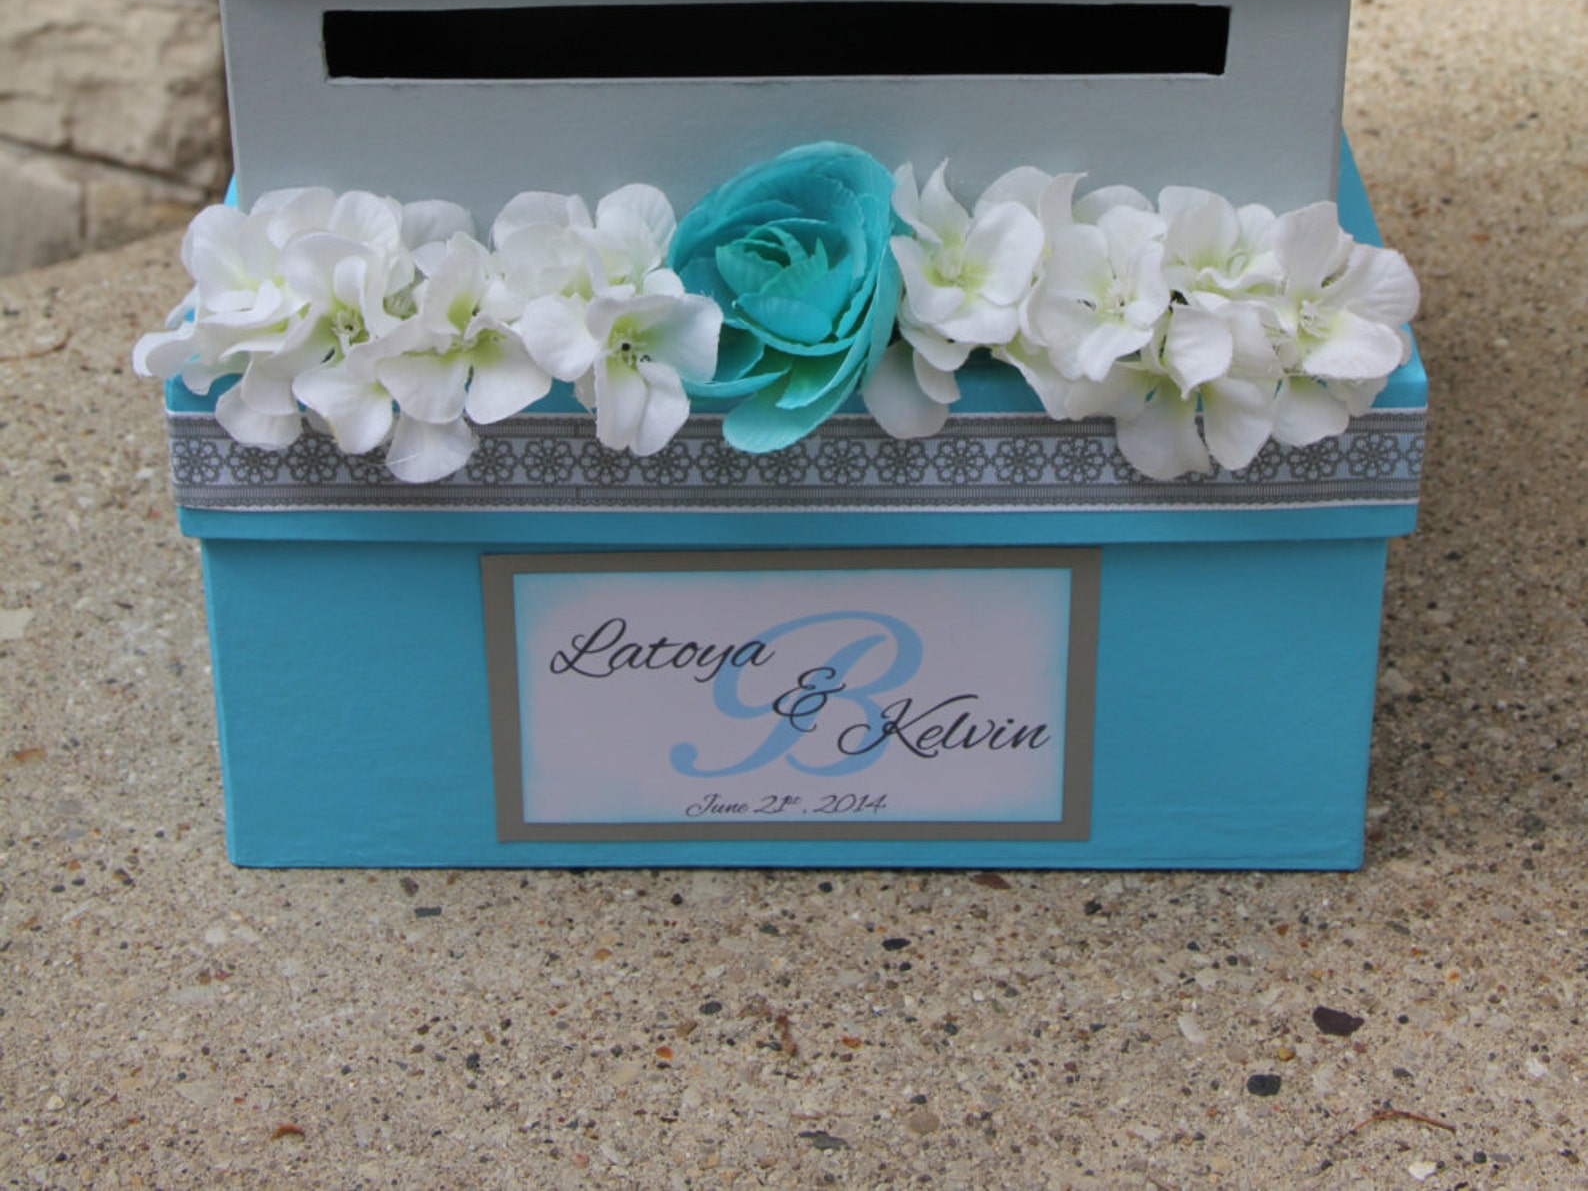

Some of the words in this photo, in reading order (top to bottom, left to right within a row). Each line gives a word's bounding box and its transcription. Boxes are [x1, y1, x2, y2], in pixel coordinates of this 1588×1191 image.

[550, 617, 774, 682] Latoya
[669, 610, 923, 778] B
[772, 667, 846, 732] &
[838, 694, 1051, 759] Kelvin
[685, 793, 749, 817] June
[812, 793, 888, 814] 2014
